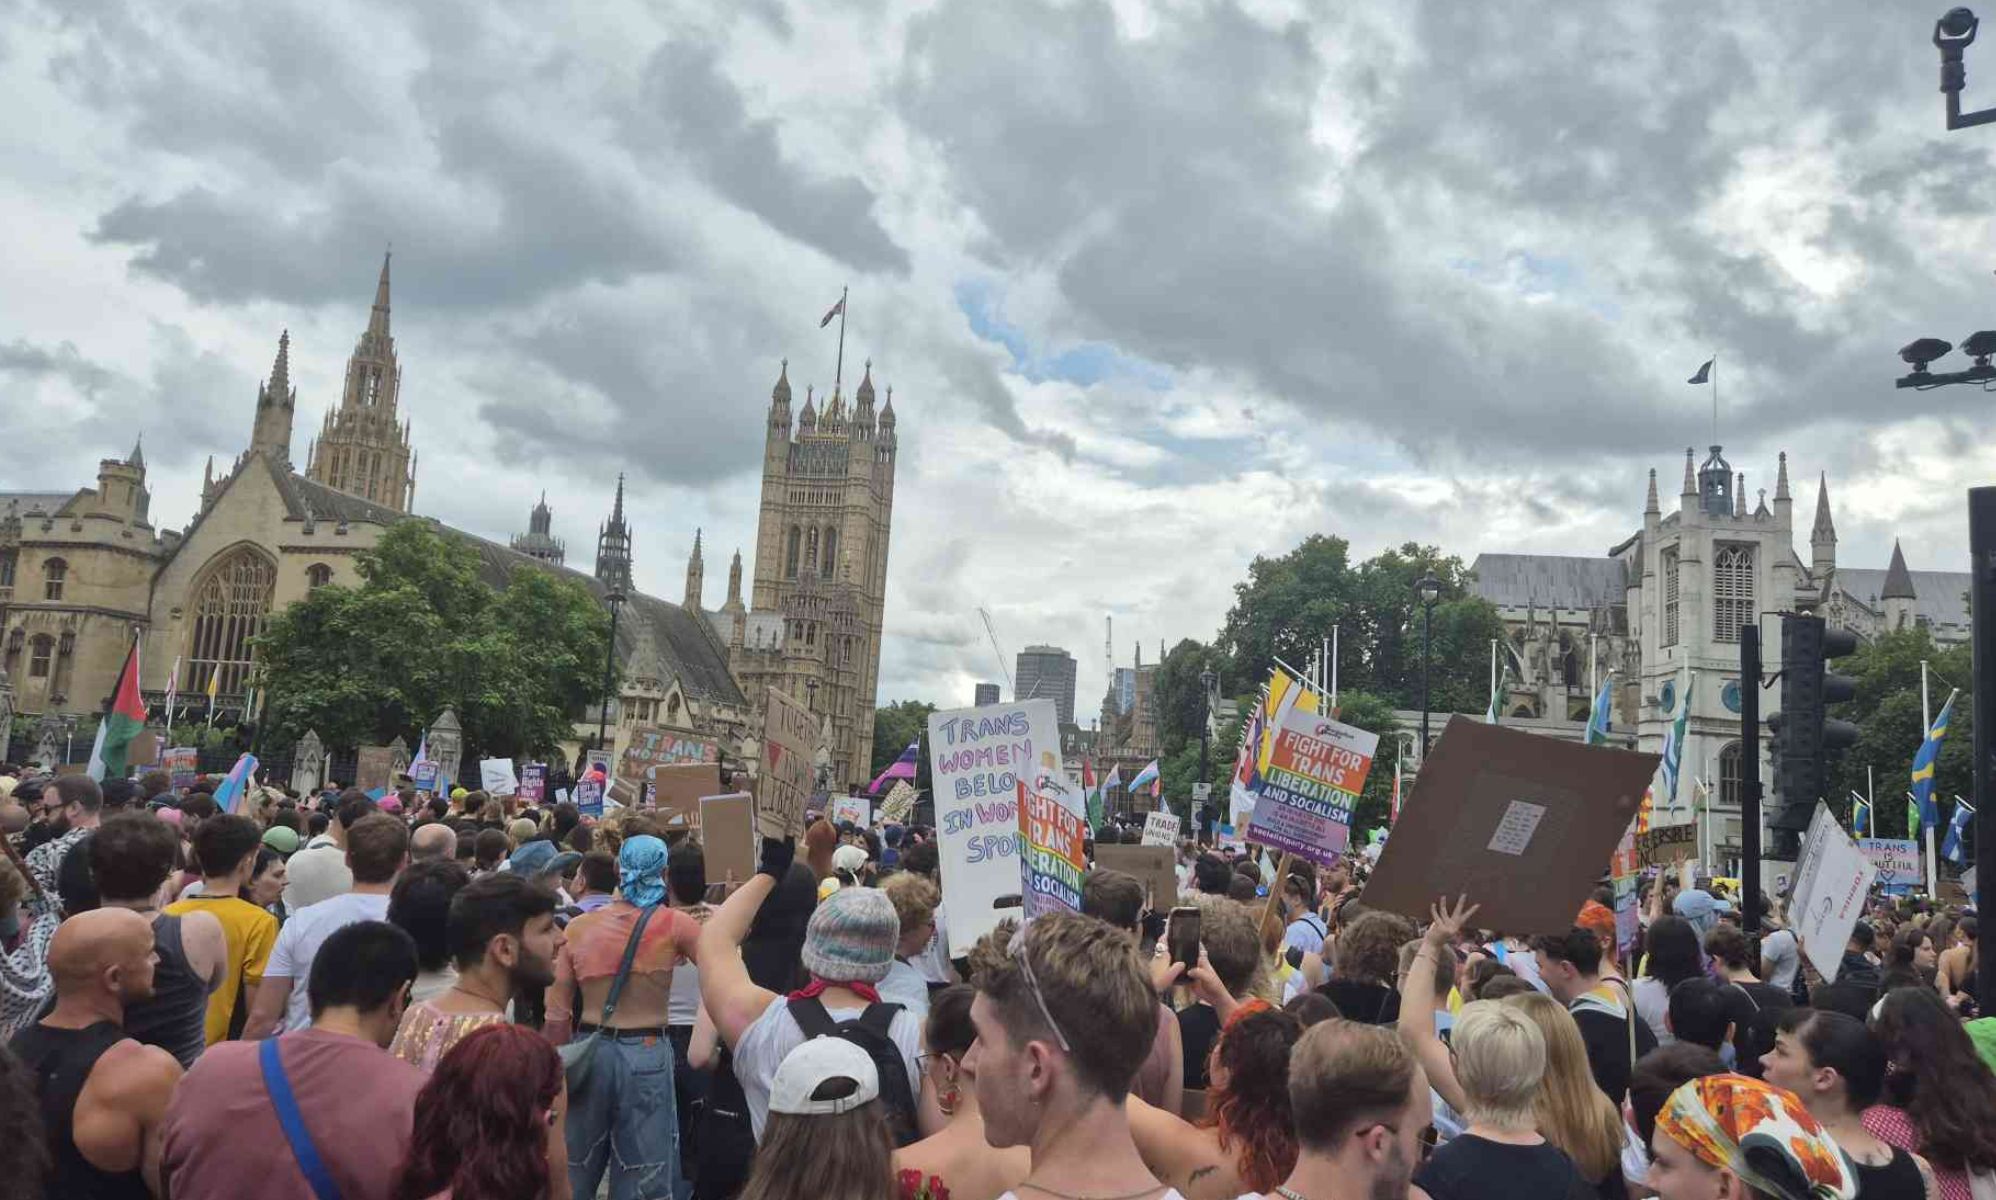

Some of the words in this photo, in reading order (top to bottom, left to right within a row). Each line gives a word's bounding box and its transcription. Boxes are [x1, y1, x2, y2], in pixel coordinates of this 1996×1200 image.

[939, 711, 1030, 745] TRANS
[939, 739, 1032, 774] WOMEN
[1285, 732, 1331, 761] FIGHT
[1331, 747, 1362, 772] FOR
[1291, 752, 1346, 785] TRANS
[955, 771, 1017, 800] BELO
[1269, 769, 1354, 810] LIBERATION
[1262, 786, 1288, 803] AND
[1289, 795, 1349, 823] SOCIALISM
[943, 808, 973, 835] IN
[1151, 817, 1178, 832] TRADE
[1869, 842, 1907, 853] TRANS
[1884, 852, 1893, 861] IS
[1033, 874, 1080, 911] SOCIALISM
